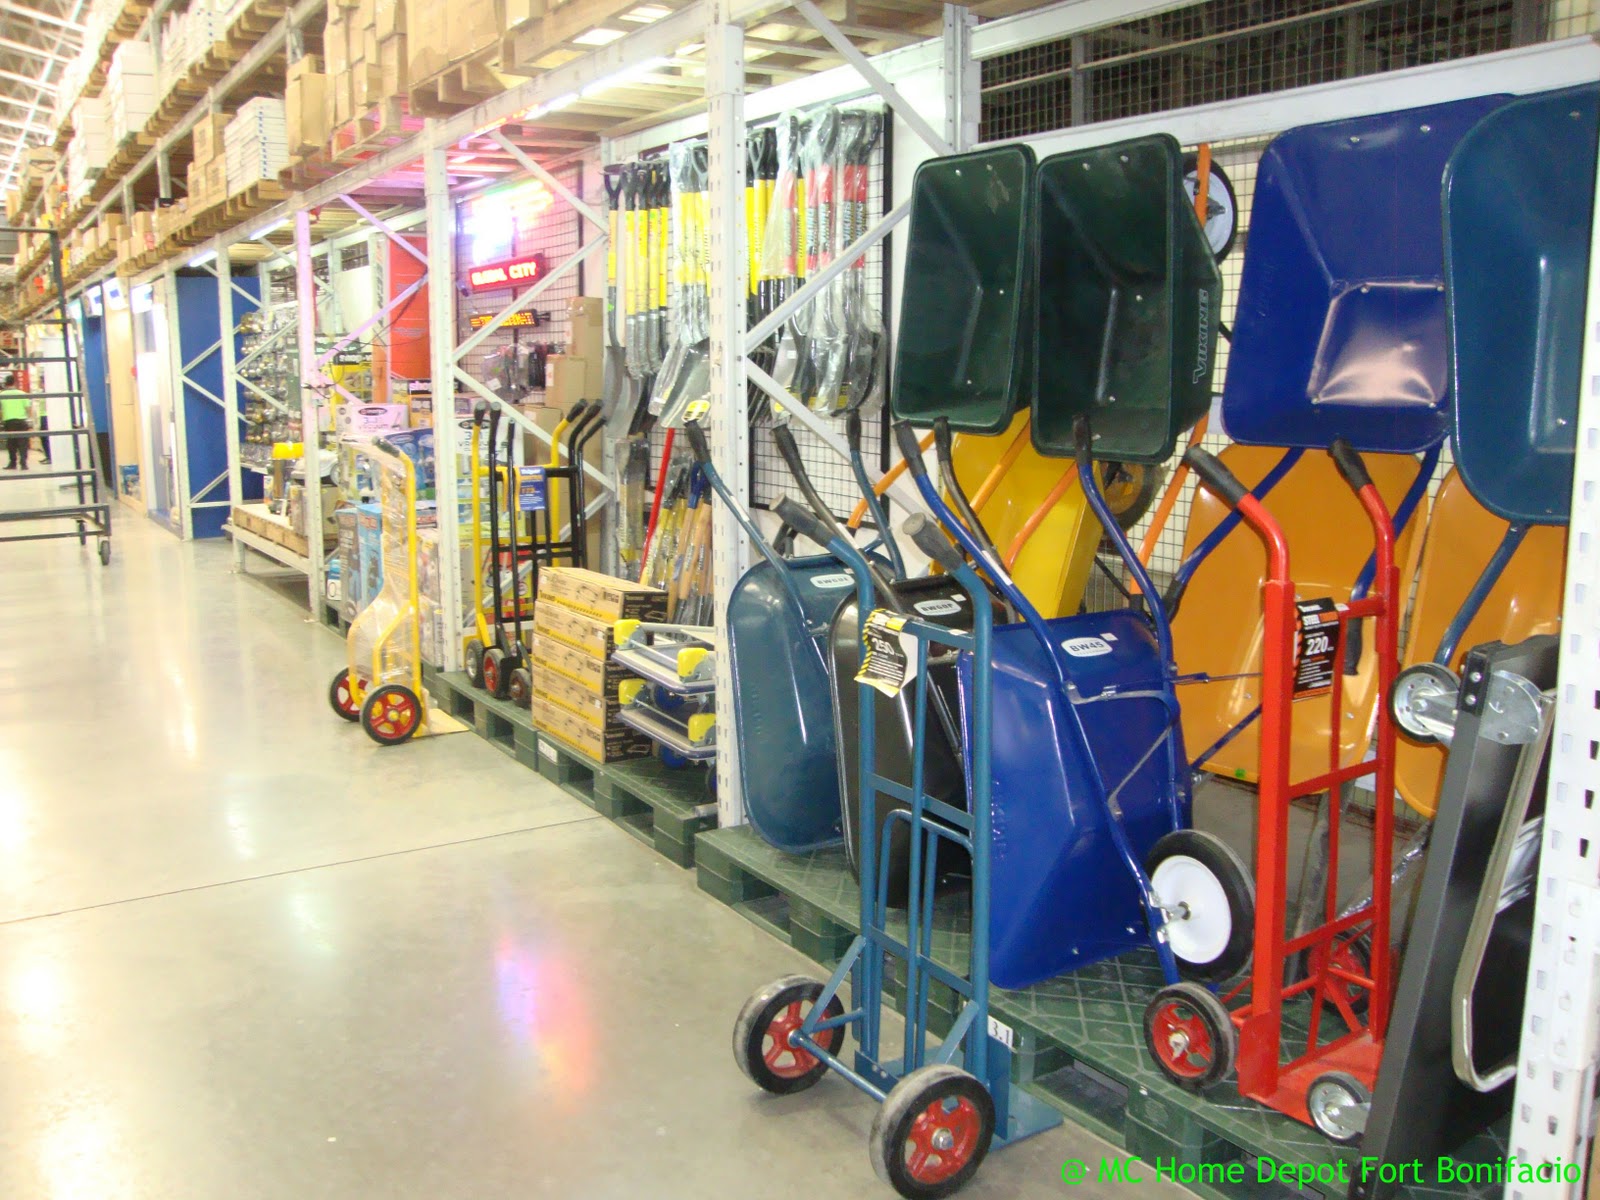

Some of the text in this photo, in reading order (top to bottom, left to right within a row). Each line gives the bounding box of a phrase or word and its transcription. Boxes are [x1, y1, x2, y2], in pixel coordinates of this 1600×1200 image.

[508, 262, 537, 279] CITY
[1192, 288, 1209, 385] VIKING
[871, 637, 895, 656] 250
[1069, 641, 1105, 652] BW45
[1305, 635, 1329, 656] 220
